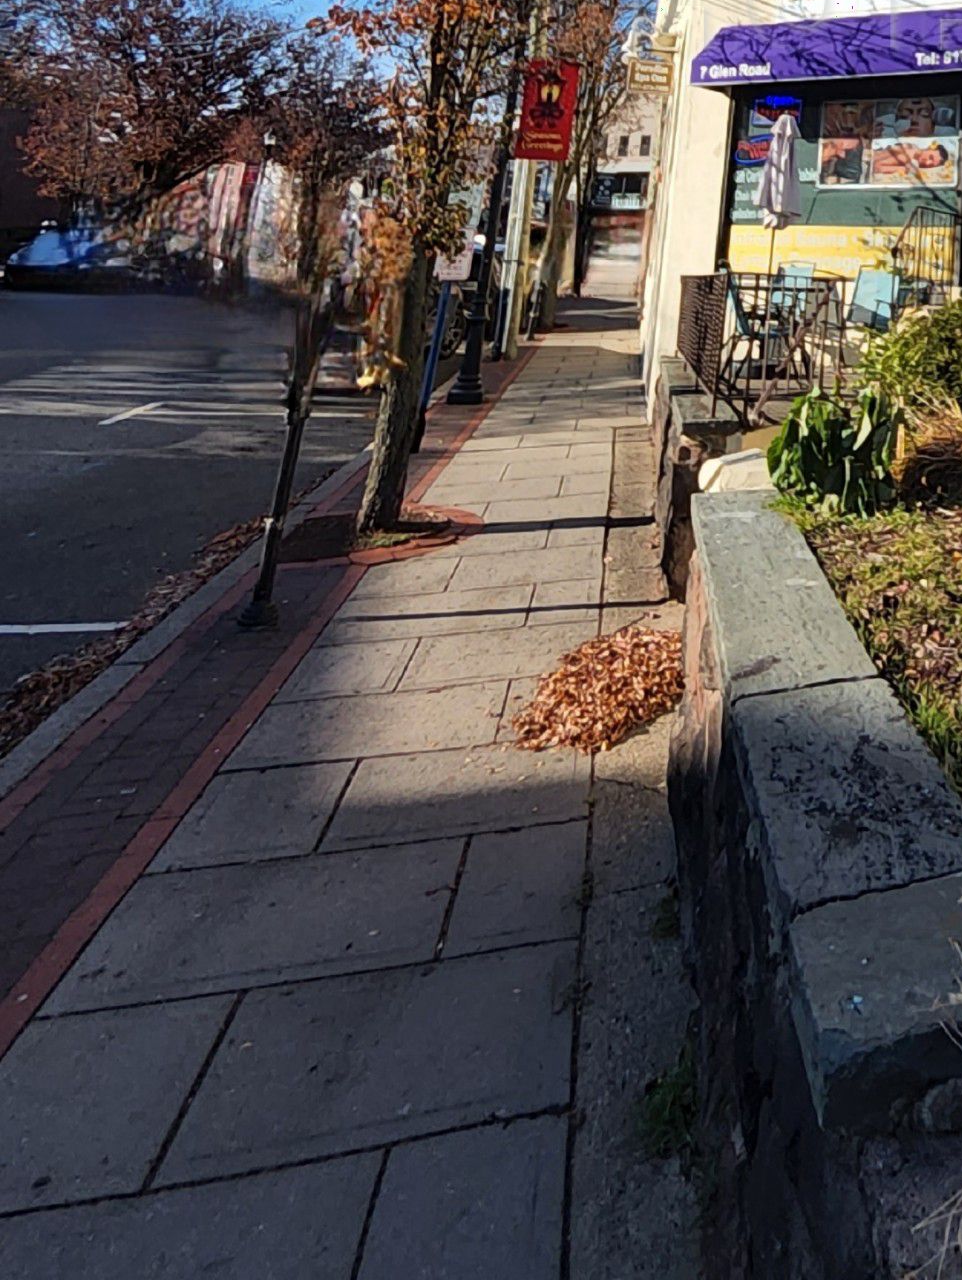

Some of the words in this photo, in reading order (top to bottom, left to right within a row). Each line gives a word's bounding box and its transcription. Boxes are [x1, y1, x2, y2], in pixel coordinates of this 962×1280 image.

[915, 52, 940, 67] Tel:
[700, 66, 708, 80] 7
[709, 64, 737, 79] Glen
[738, 62, 771, 77] Road
